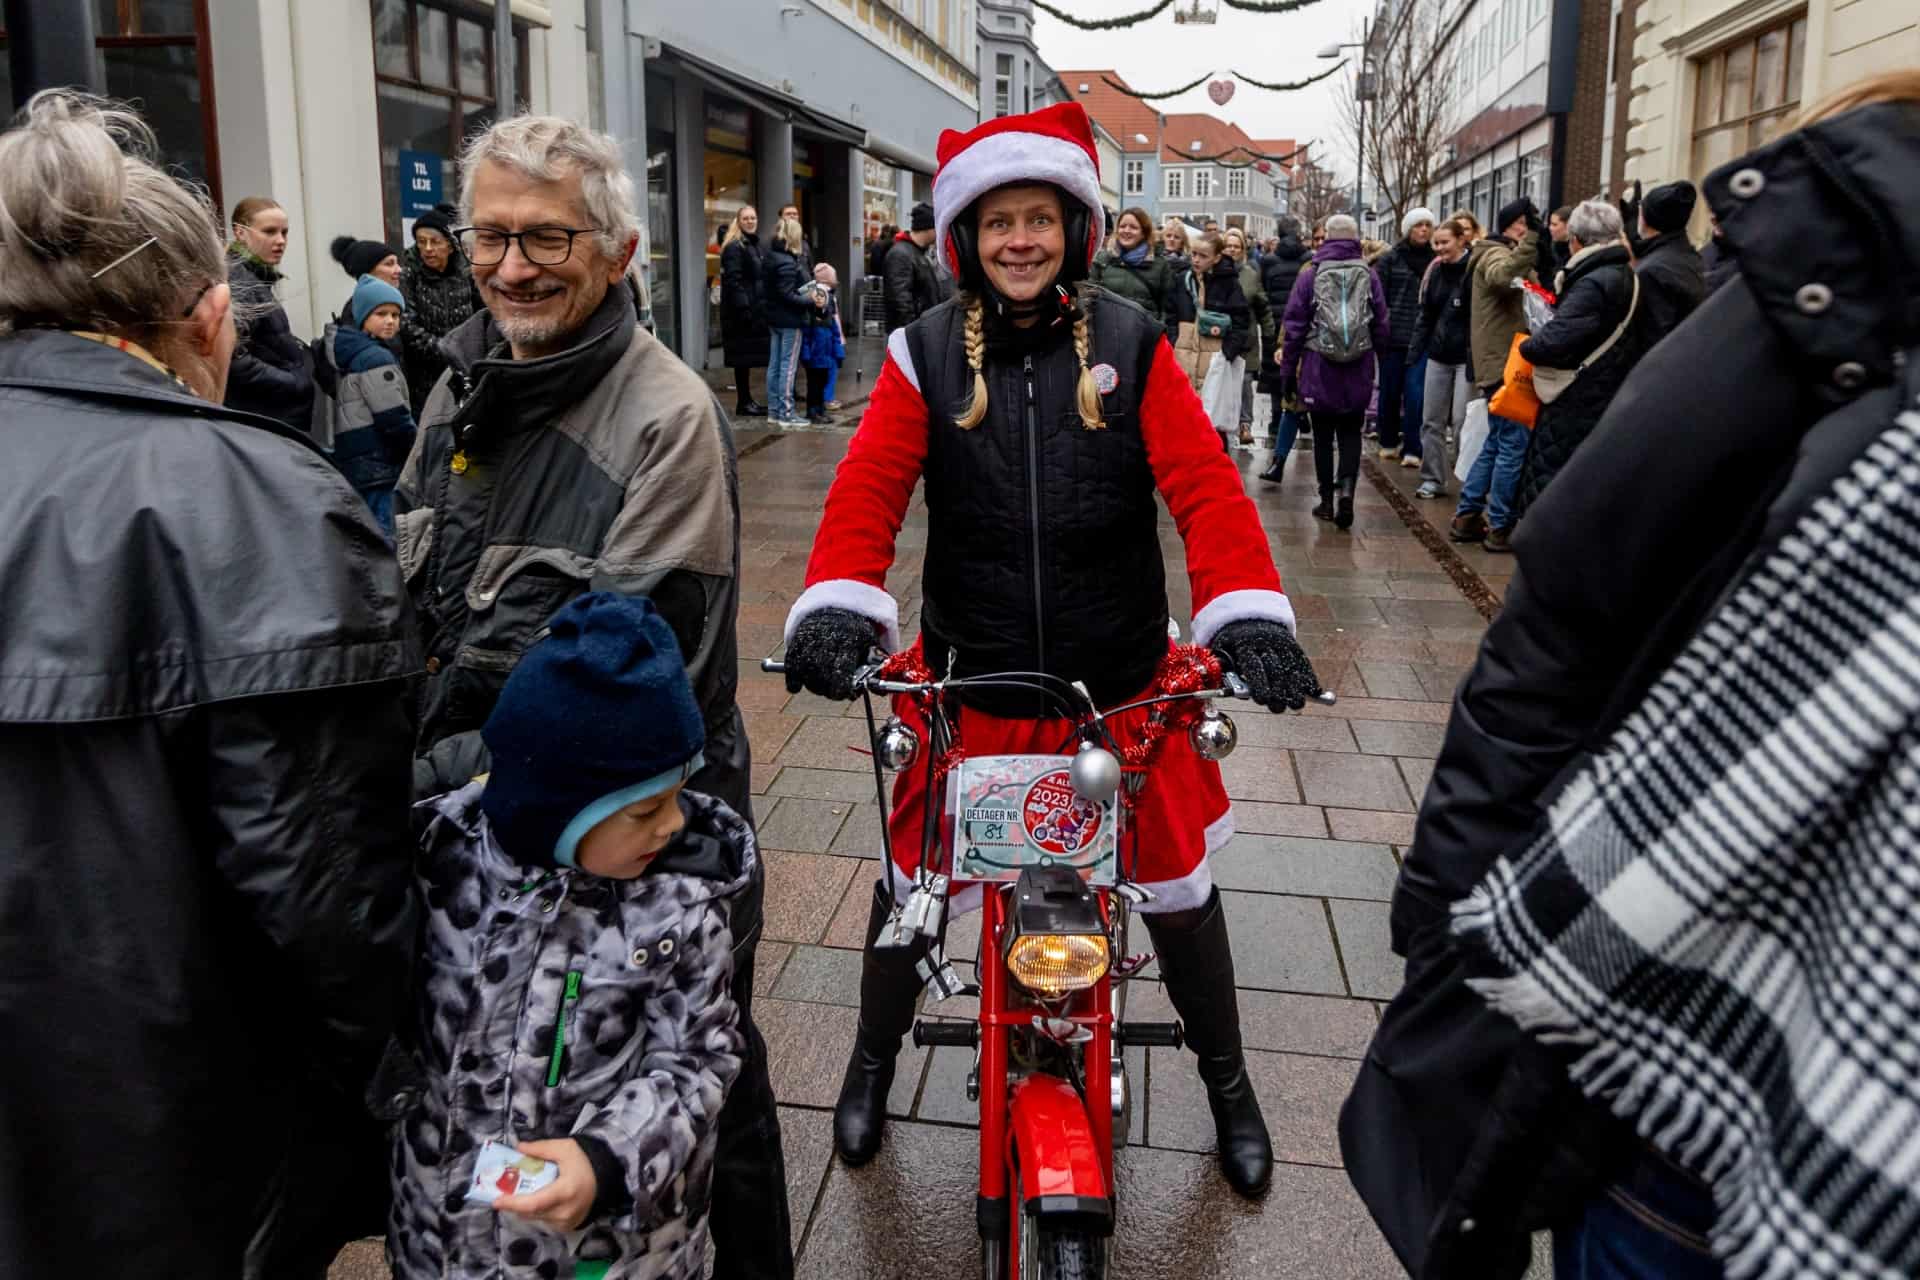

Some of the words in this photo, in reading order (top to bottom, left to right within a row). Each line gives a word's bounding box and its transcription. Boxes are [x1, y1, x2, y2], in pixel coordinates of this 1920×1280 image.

[414, 162, 428, 175] TIL
[412, 178, 431, 191] LEJE
[1032, 788, 1069, 807] 2023
[967, 809, 1005, 820] DELTAGER
[984, 823, 1004, 840] 81
